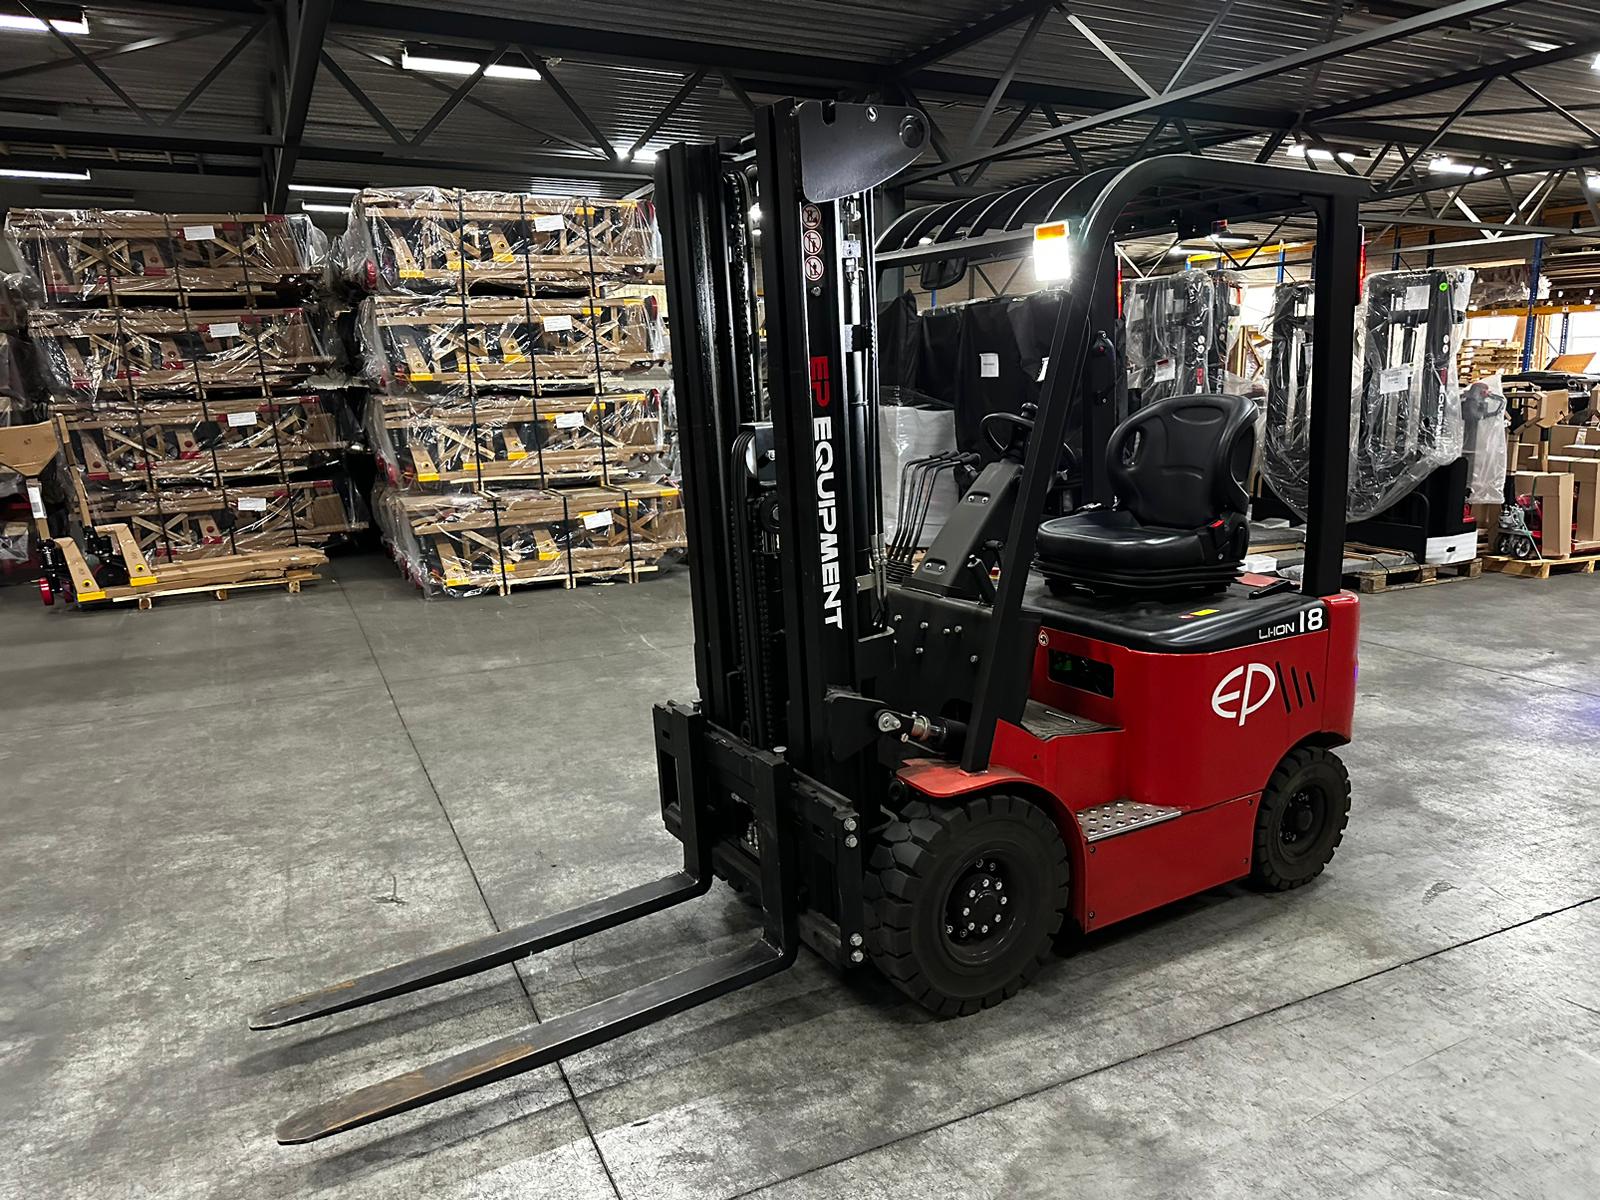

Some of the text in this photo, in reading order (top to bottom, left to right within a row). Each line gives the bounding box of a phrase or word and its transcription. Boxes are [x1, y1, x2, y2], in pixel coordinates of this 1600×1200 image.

[810, 356, 843, 630] EP EQUIPMENT
[1299, 607, 1323, 633] 18
[1211, 662, 1276, 727] EP
